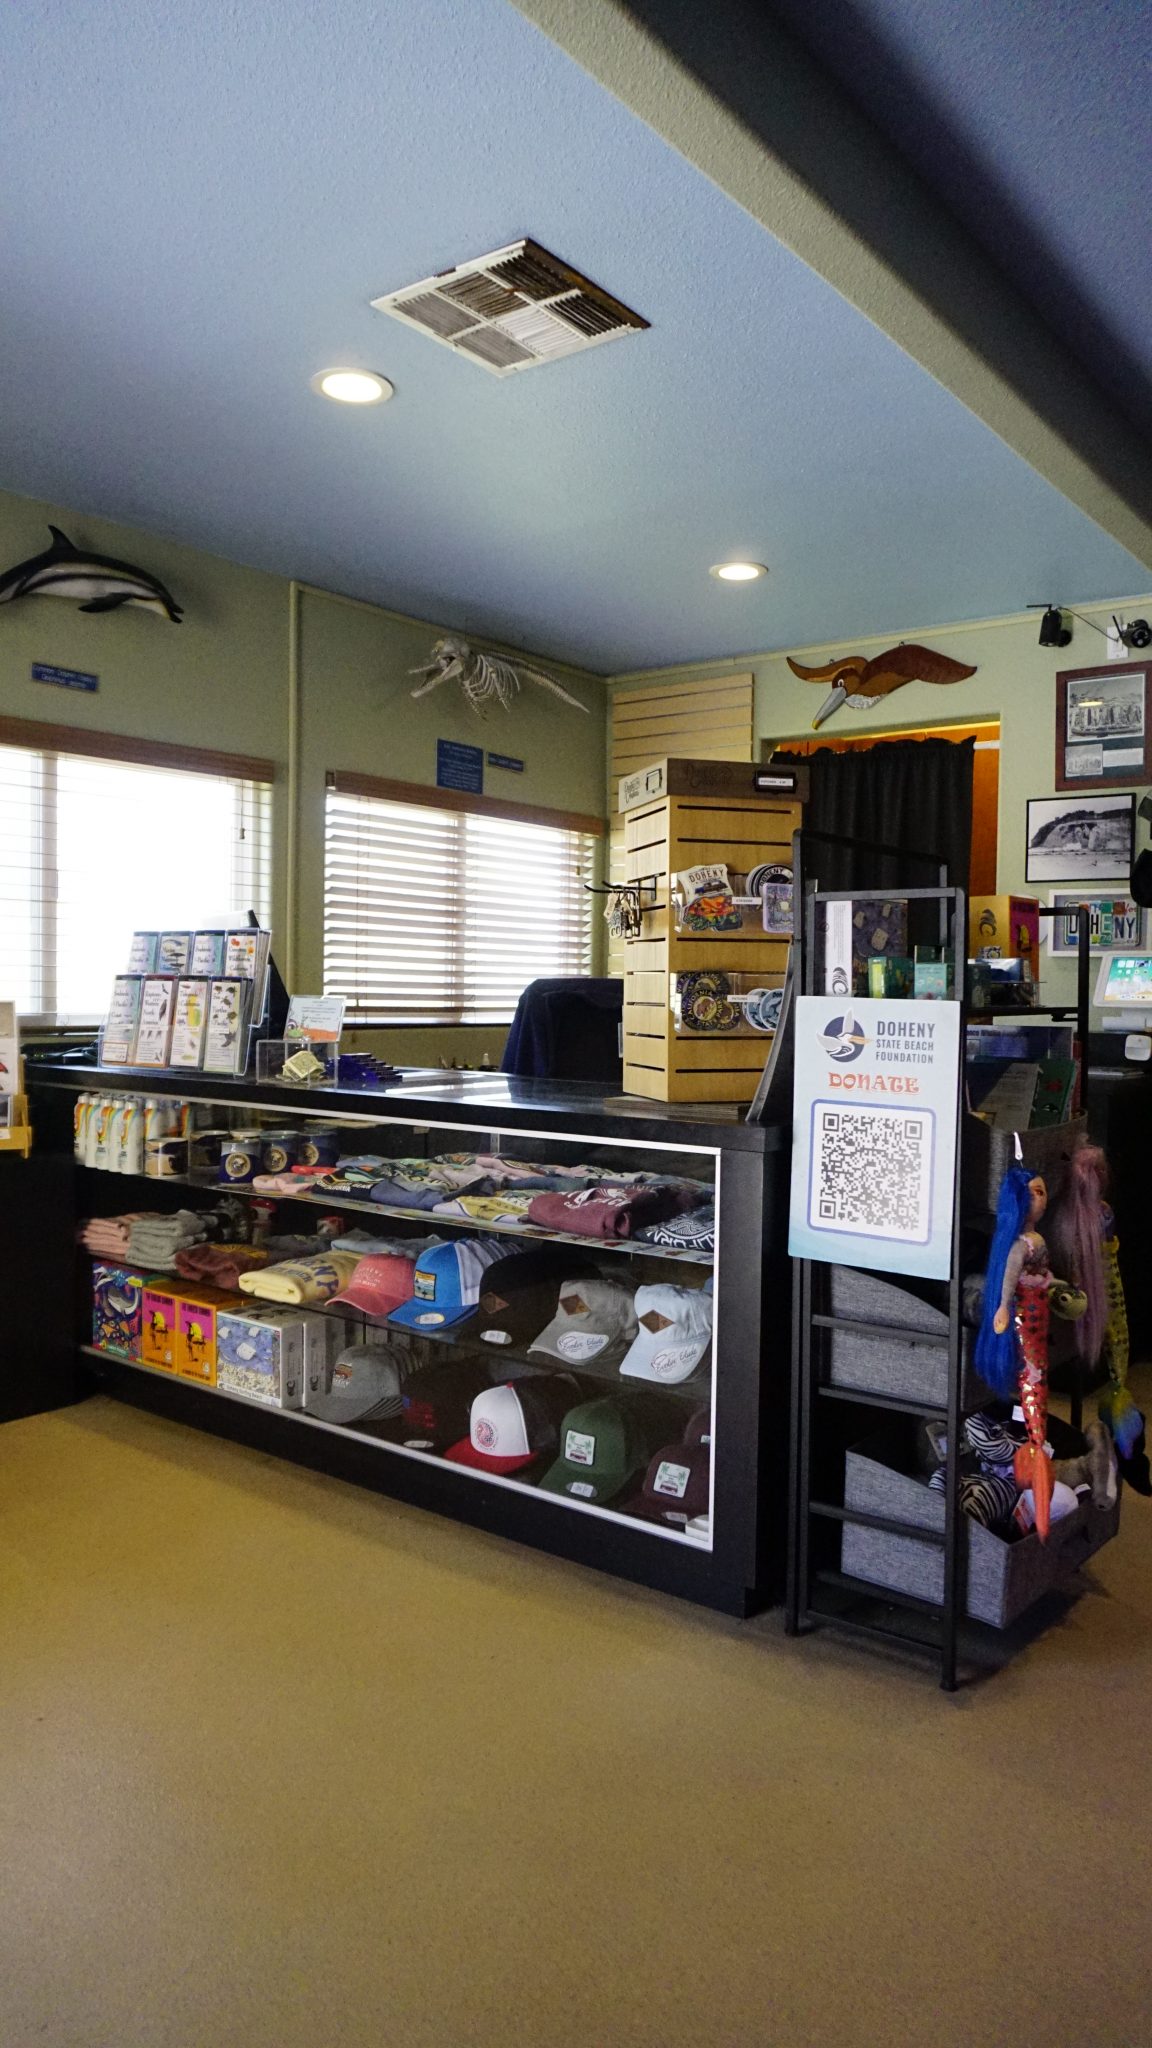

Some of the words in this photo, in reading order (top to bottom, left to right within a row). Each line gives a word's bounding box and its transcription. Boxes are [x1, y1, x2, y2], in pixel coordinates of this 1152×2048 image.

[688, 869, 724, 883] DOHENY
[1069, 914, 1136, 939] DHENY
[877, 1020, 936, 1039] DOHENY
[876, 1039, 901, 1050] STATE
[904, 1041, 934, 1052] BEACH
[876, 1051, 934, 1065] FOUNDATION
[828, 1071, 920, 1094] DONATE
